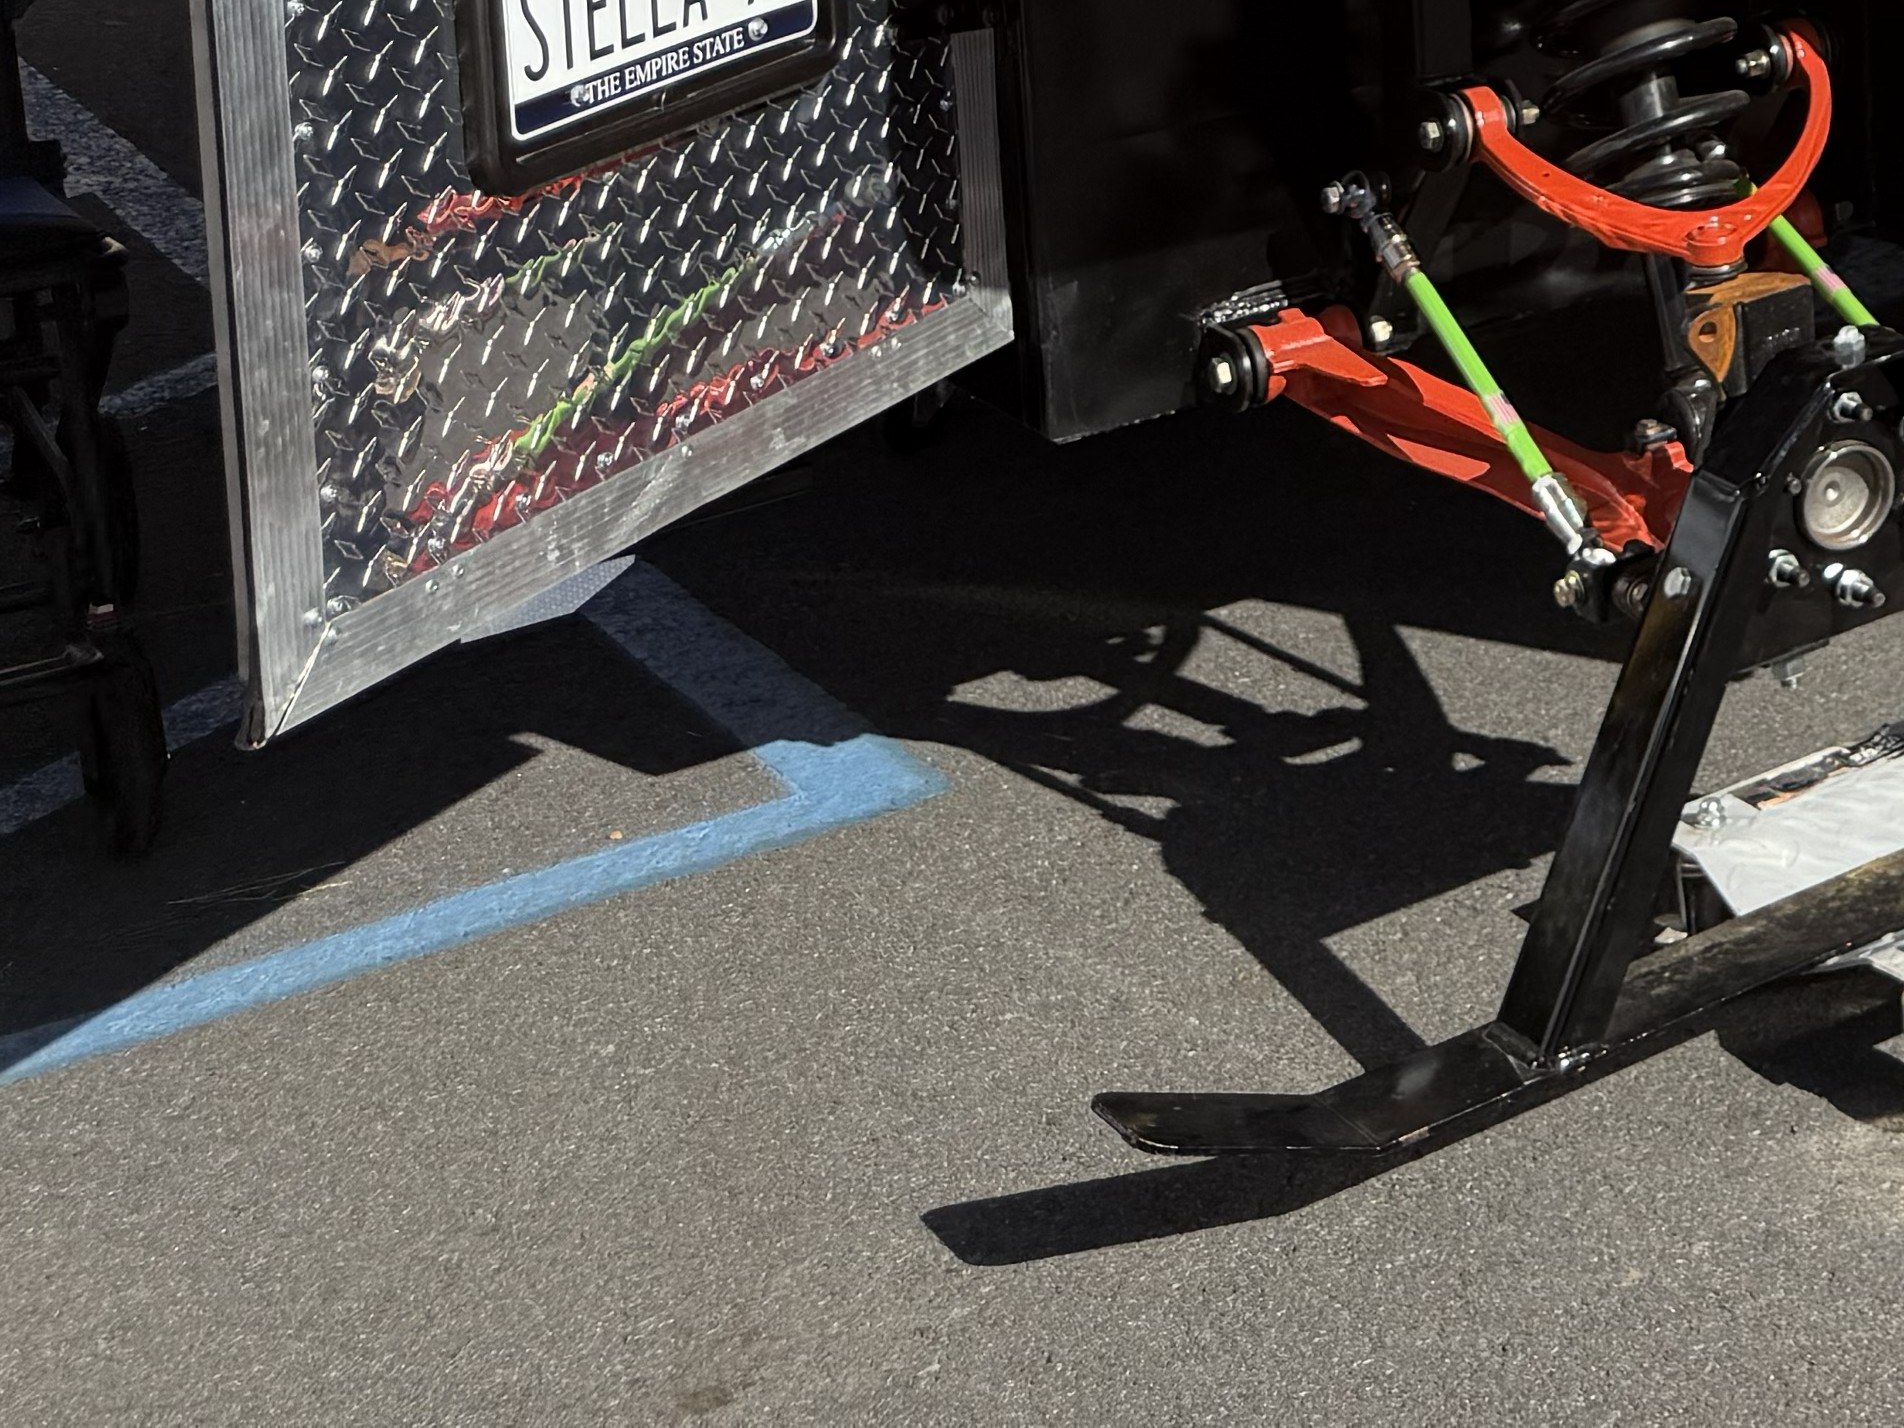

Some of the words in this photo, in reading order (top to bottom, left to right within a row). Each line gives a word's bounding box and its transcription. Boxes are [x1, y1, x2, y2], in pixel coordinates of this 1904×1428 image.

[585, 71, 621, 104] THE
[624, 44, 690, 91] EMPIRE
[692, 27, 745, 70] STATE
